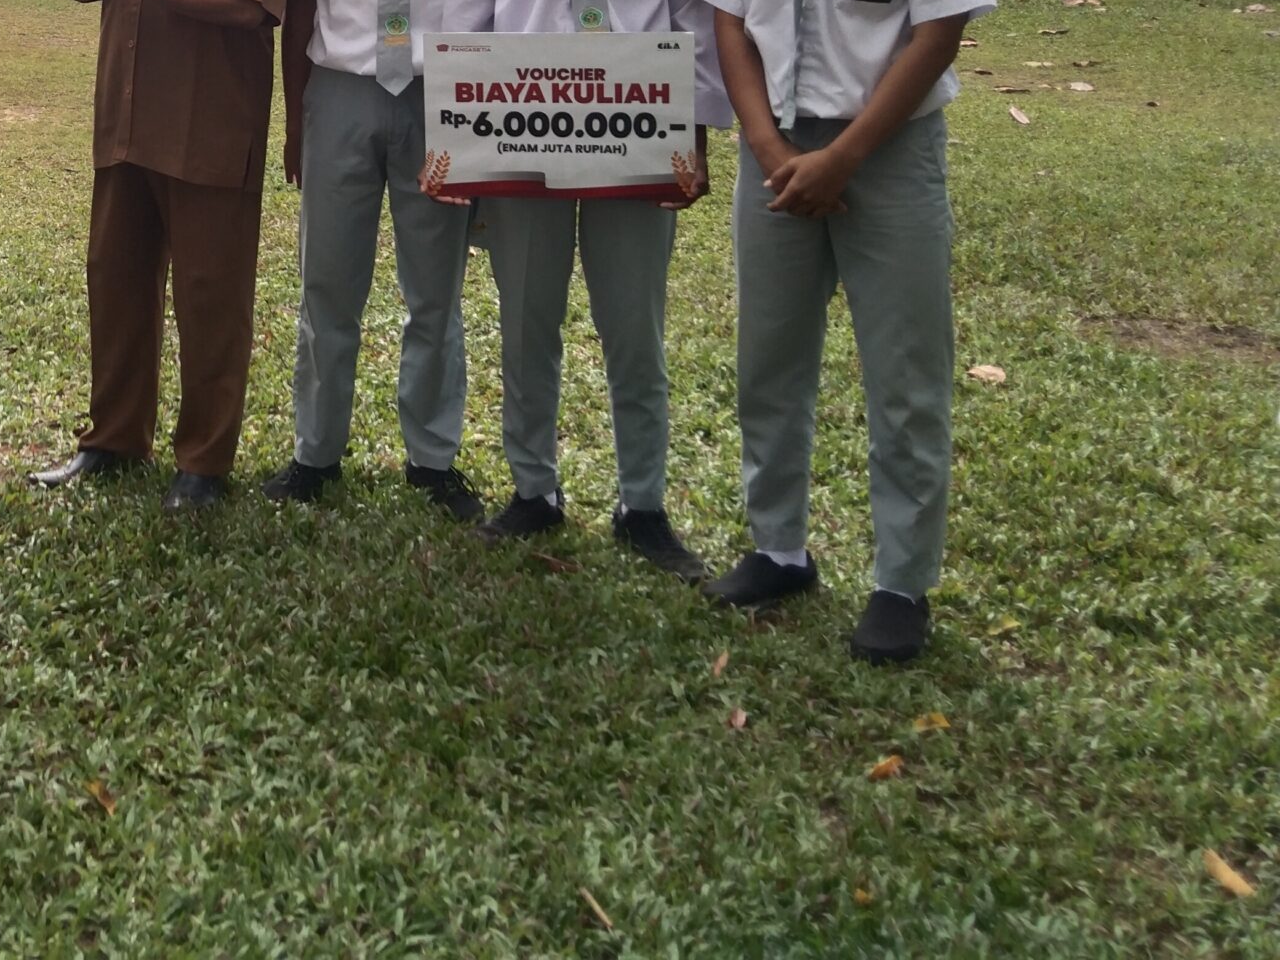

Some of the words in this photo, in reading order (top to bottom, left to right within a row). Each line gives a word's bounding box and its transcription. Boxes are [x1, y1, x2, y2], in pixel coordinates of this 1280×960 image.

[516, 68, 606, 81] VOUCHER
[455, 82, 546, 103] BIAYA
[551, 82, 670, 104] KULIAH
[497, 141, 538, 155] (ENAM
[540, 144, 573, 153] JUTA
[575, 142, 627, 157] RUPIAH)
